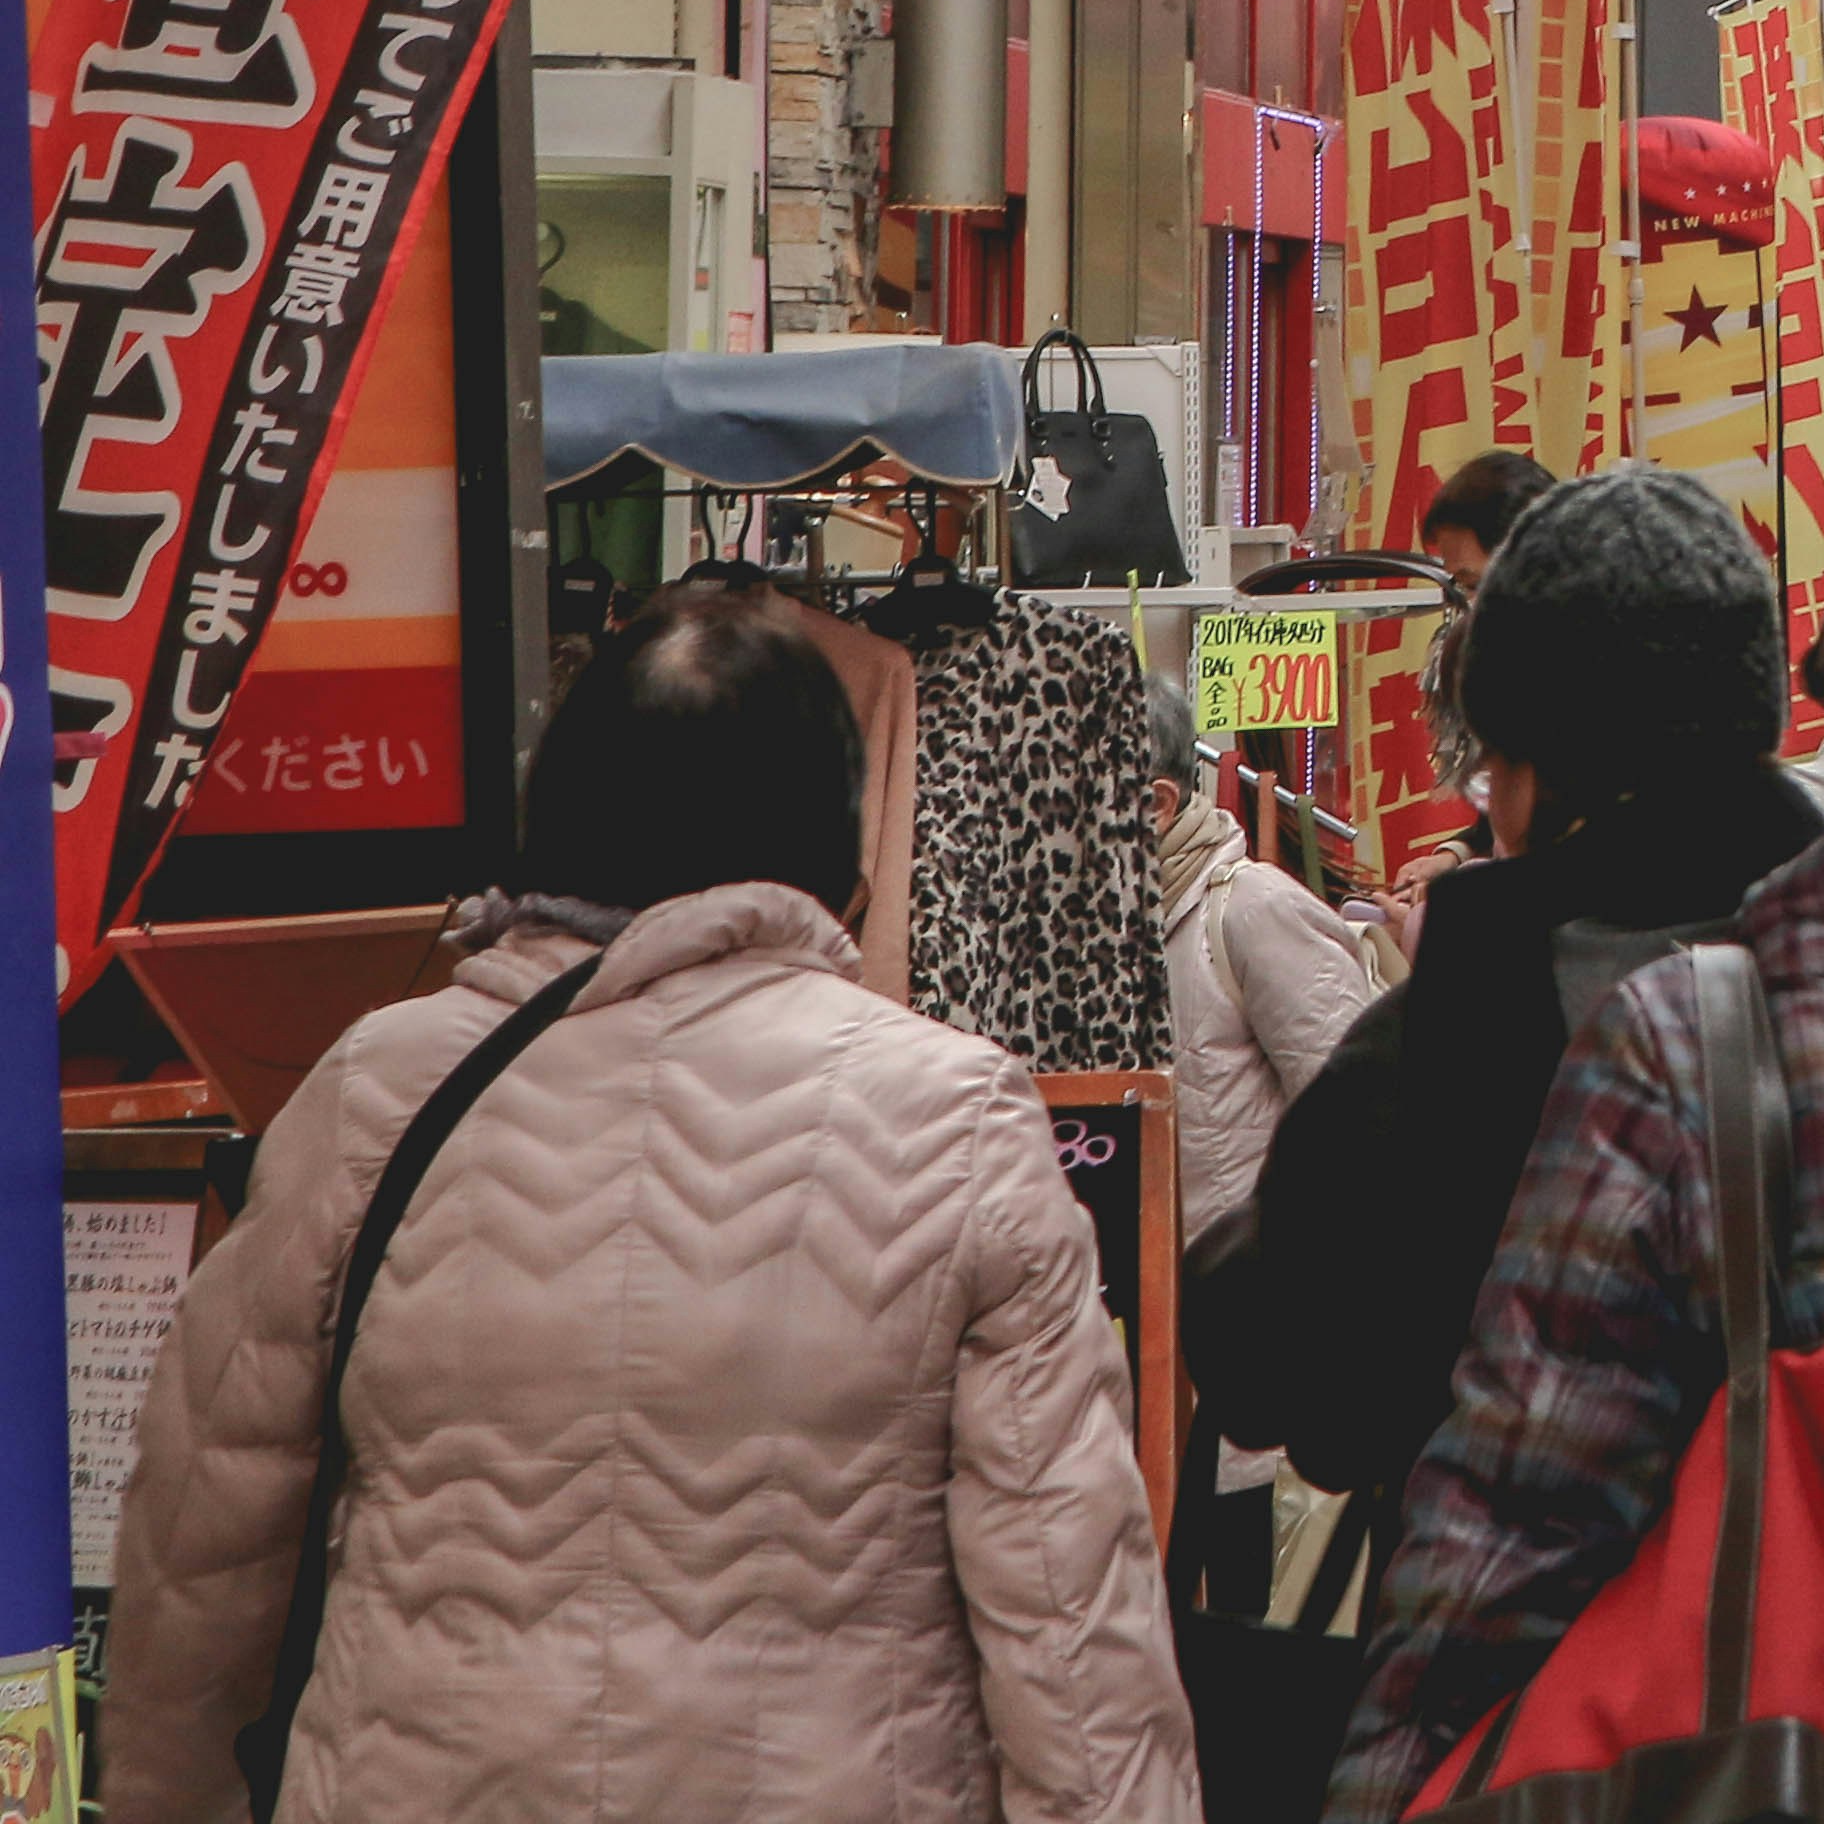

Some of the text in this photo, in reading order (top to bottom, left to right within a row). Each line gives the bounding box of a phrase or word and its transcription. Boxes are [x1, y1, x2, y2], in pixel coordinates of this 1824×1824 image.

[1653, 214, 1703, 234] NEW
[1202, 655, 1235, 679] BAG
[1204, 680, 1229, 730] 全品
